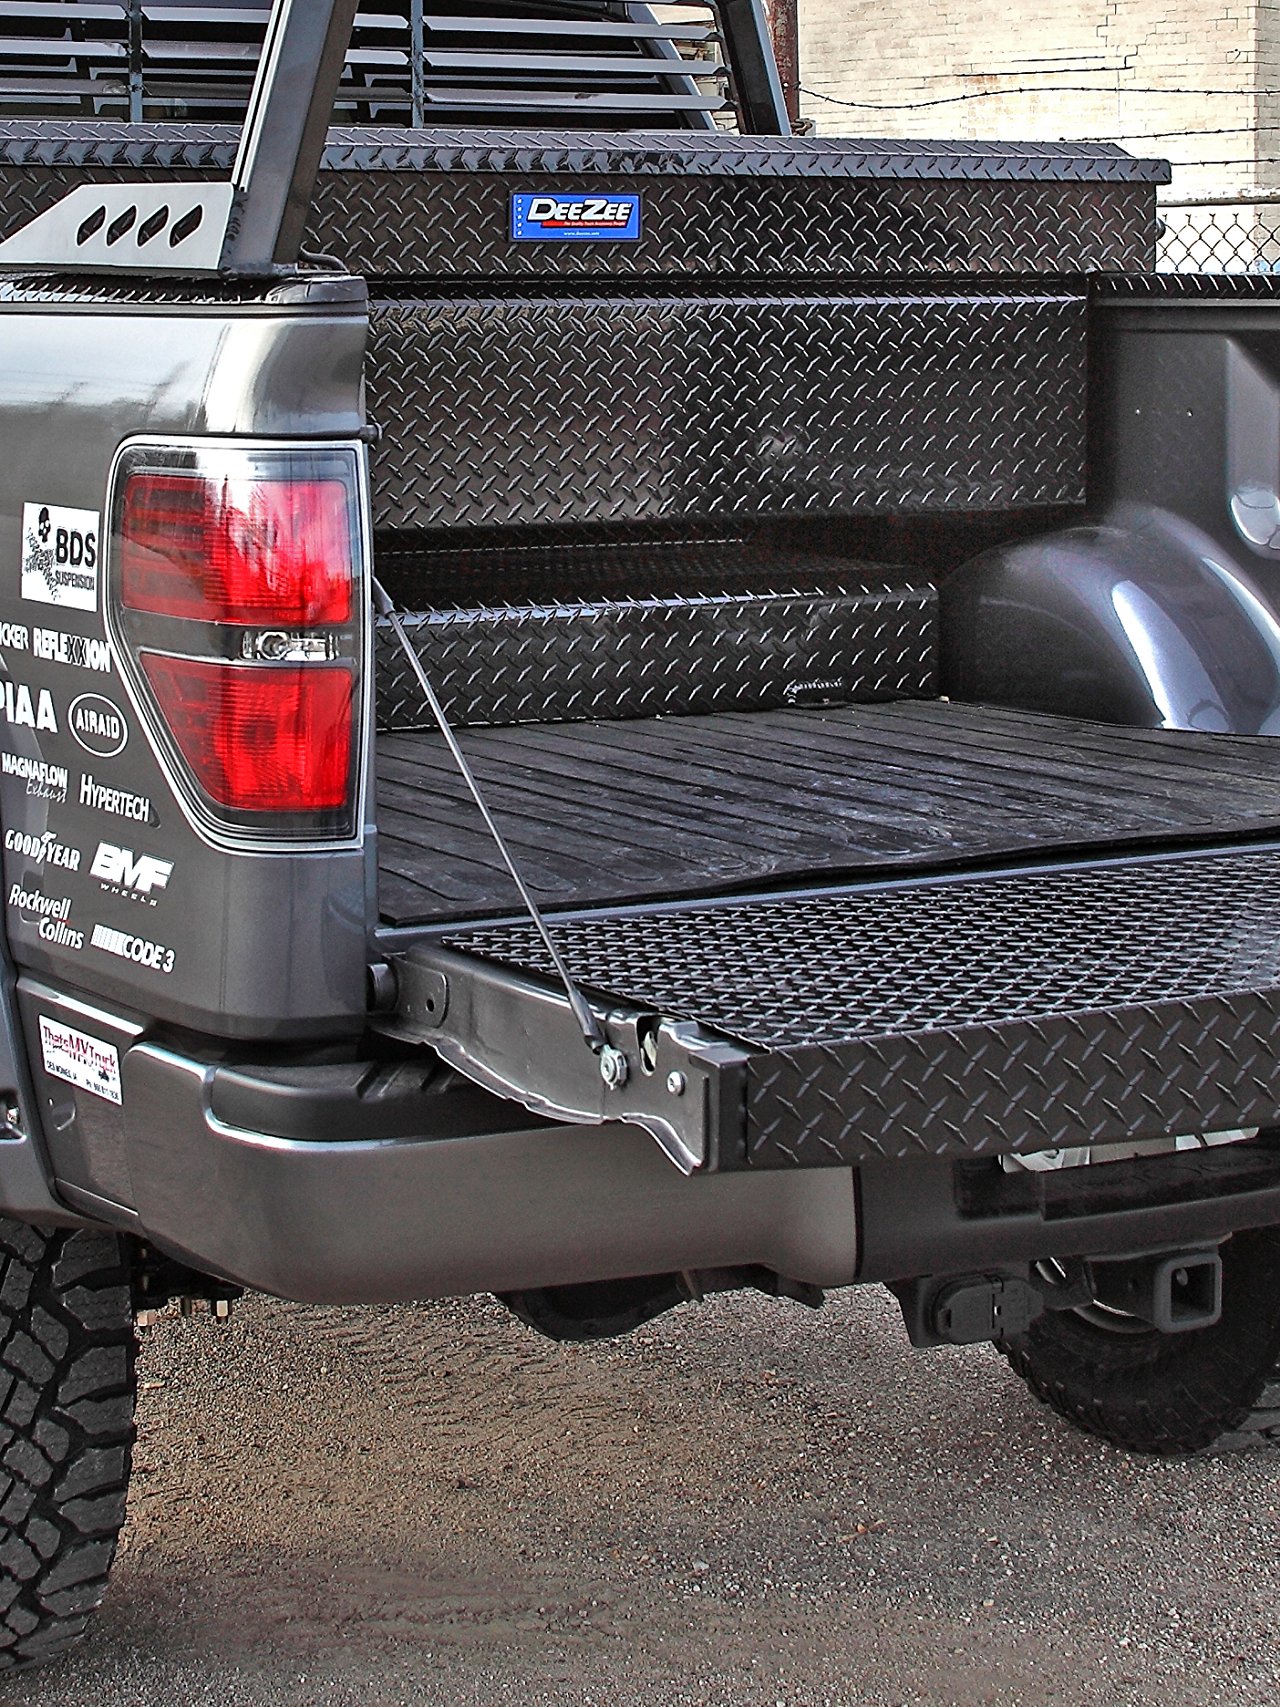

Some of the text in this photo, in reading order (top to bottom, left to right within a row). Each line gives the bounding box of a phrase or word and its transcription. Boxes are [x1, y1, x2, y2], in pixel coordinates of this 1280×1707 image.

[56, 528, 96, 568] BDS
[55, 570, 95, 591] SUSPENSION
[0, 680, 58, 733] IAA
[76, 708, 120, 740] AIRAID
[2, 752, 68, 788] MAGNAFLOW
[79, 773, 150, 822] HYPERTECH
[5, 829, 81, 871] GOODYEAR
[89, 841, 175, 894] BMF
[8, 883, 72, 921] Rockwell
[100, 883, 158, 906] WHEELS
[38, 916, 85, 950] Collins
[122, 935, 175, 973] CODE 3
